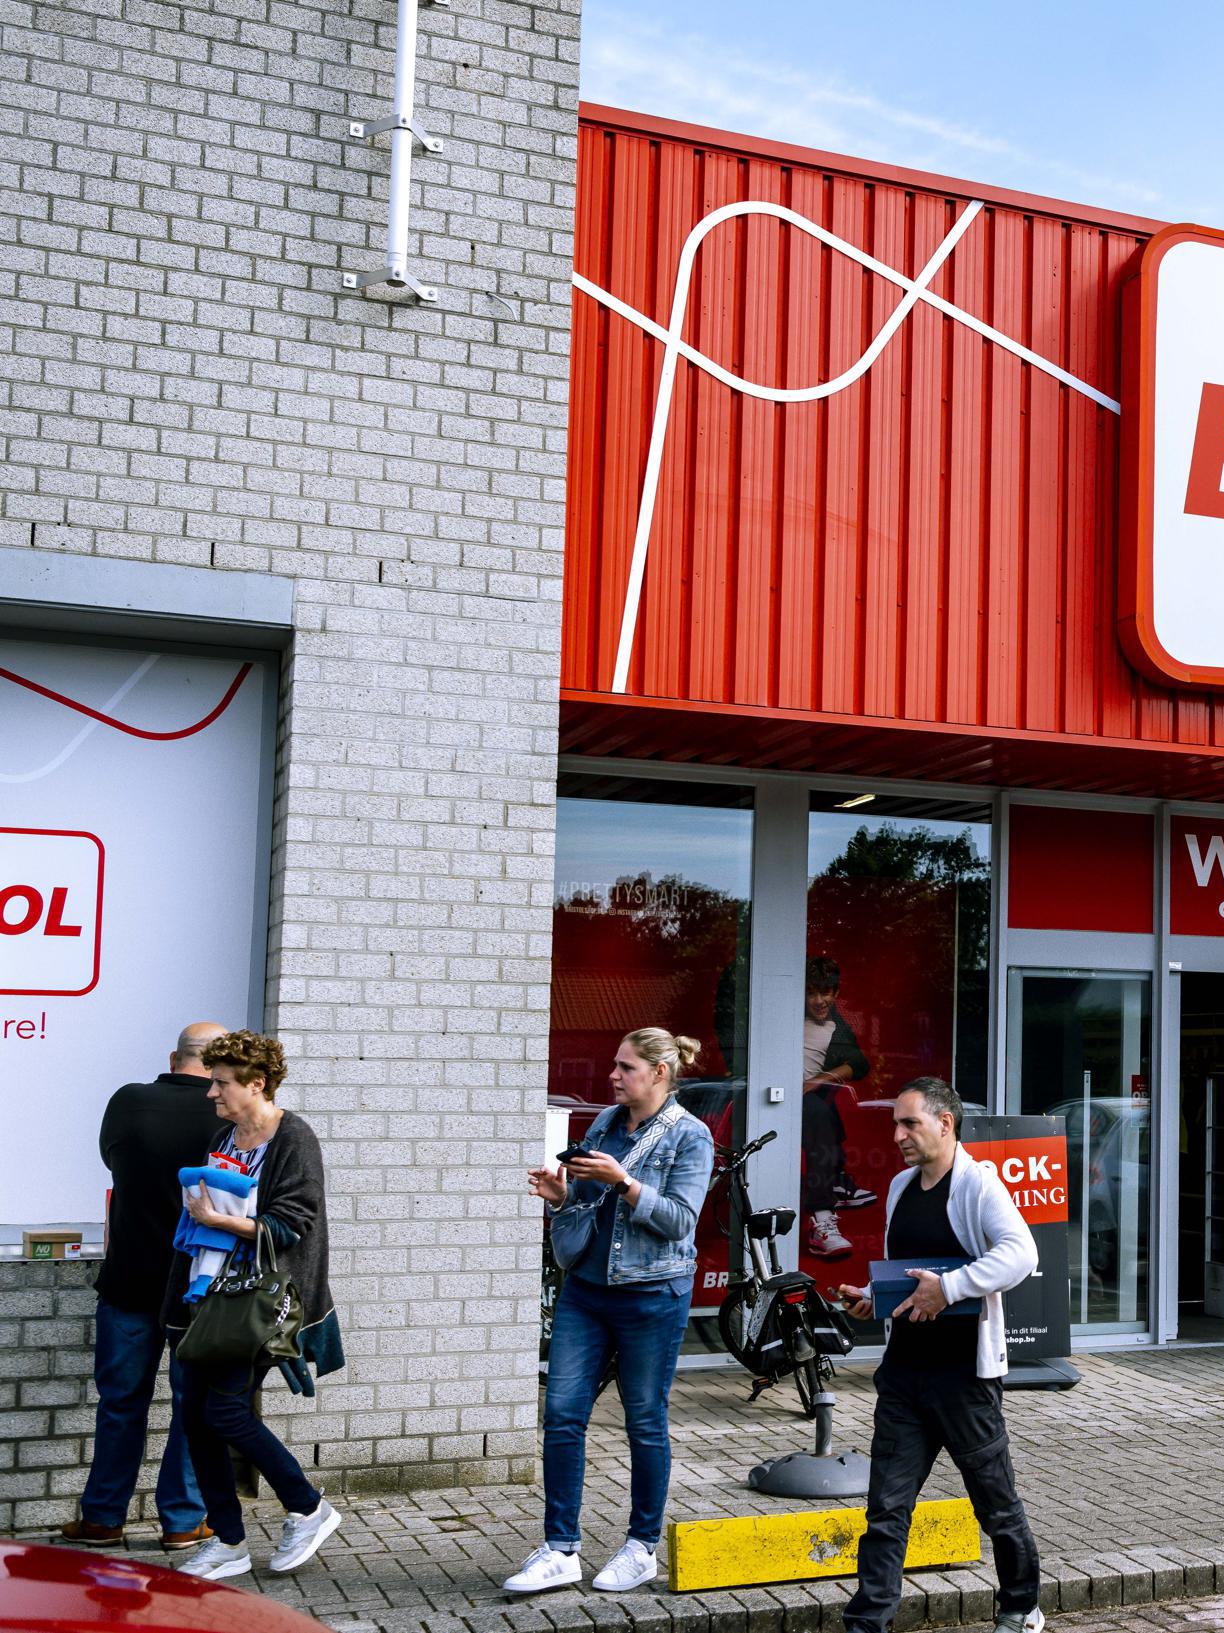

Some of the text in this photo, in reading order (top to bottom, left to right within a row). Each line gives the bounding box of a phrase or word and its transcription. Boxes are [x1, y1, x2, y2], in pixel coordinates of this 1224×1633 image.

[559, 880, 690, 905] #PRETTYSMART
[1011, 1327, 1018, 1335] in
[1019, 1326, 1029, 1334] dit
[1030, 1325, 1048, 1334] filiaal
